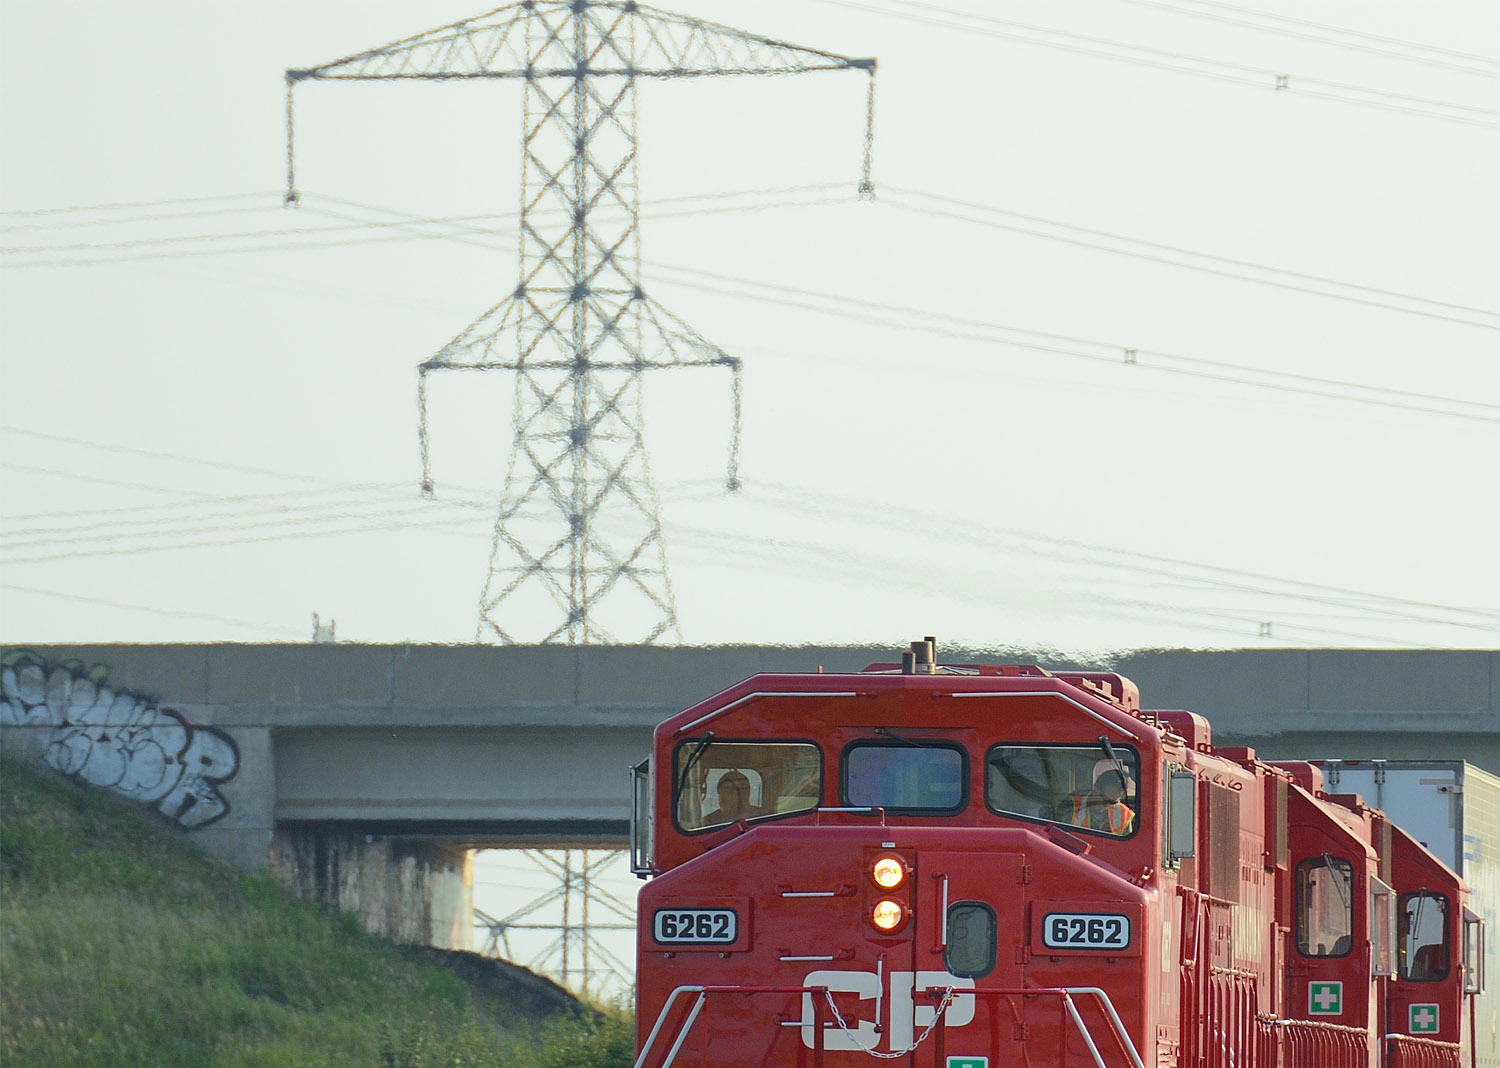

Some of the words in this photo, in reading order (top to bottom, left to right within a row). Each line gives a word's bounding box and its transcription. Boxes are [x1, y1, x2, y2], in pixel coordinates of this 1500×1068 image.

[661, 914, 729, 938] 6262
[1052, 919, 1122, 944] 6262
[802, 970, 975, 1051] CP
